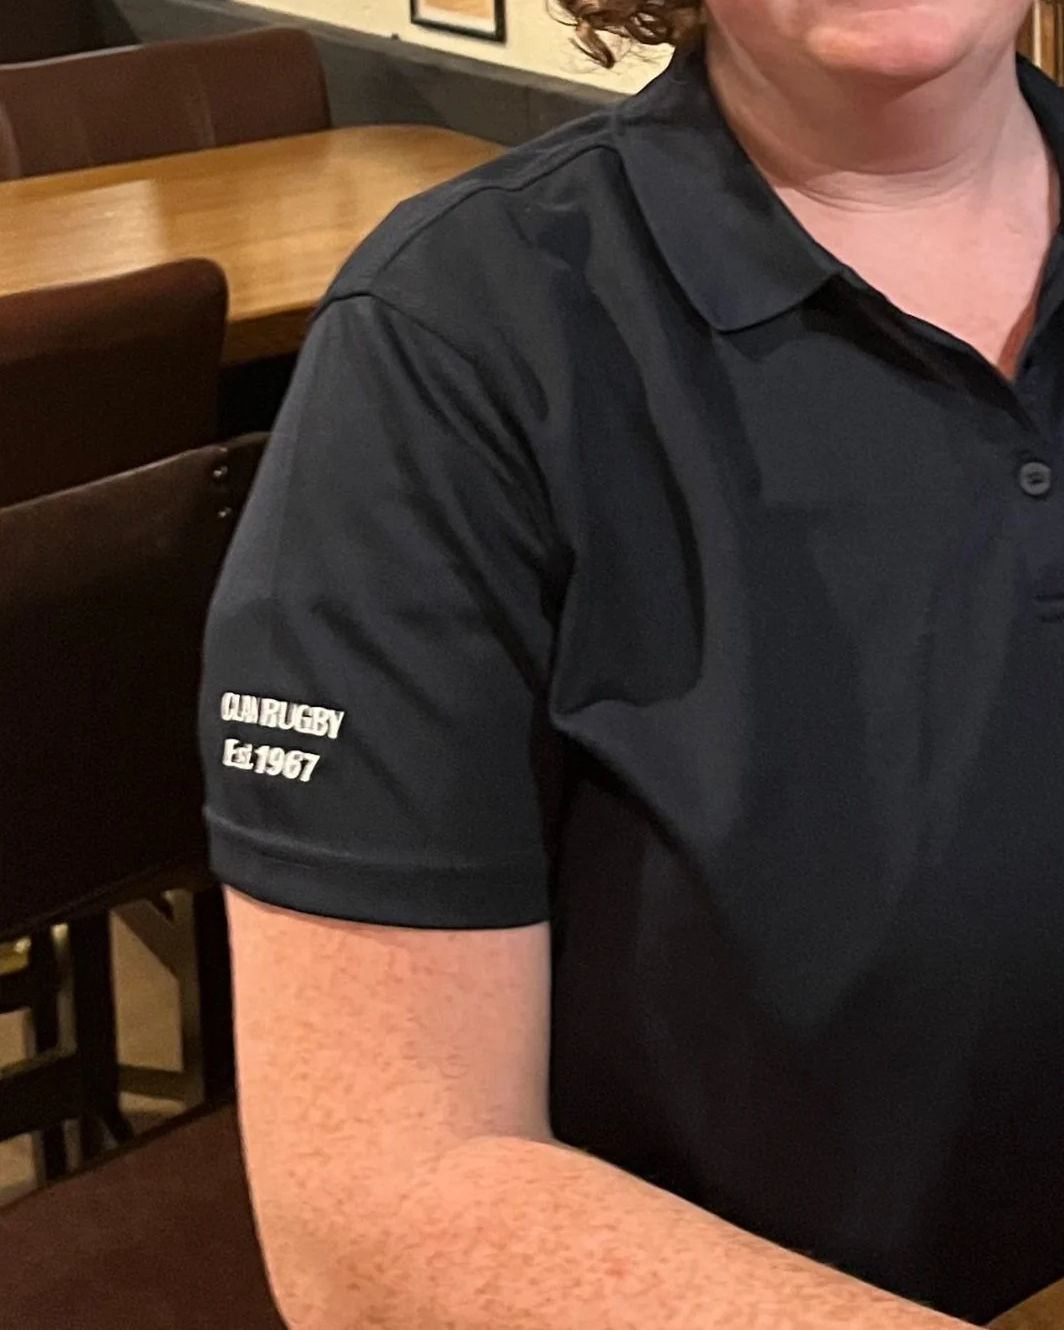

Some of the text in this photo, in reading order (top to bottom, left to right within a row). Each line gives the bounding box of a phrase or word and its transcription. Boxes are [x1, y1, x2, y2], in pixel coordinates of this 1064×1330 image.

[221, 692, 345, 739] CLAN RUGBY
[254, 745, 320, 782] 1967
